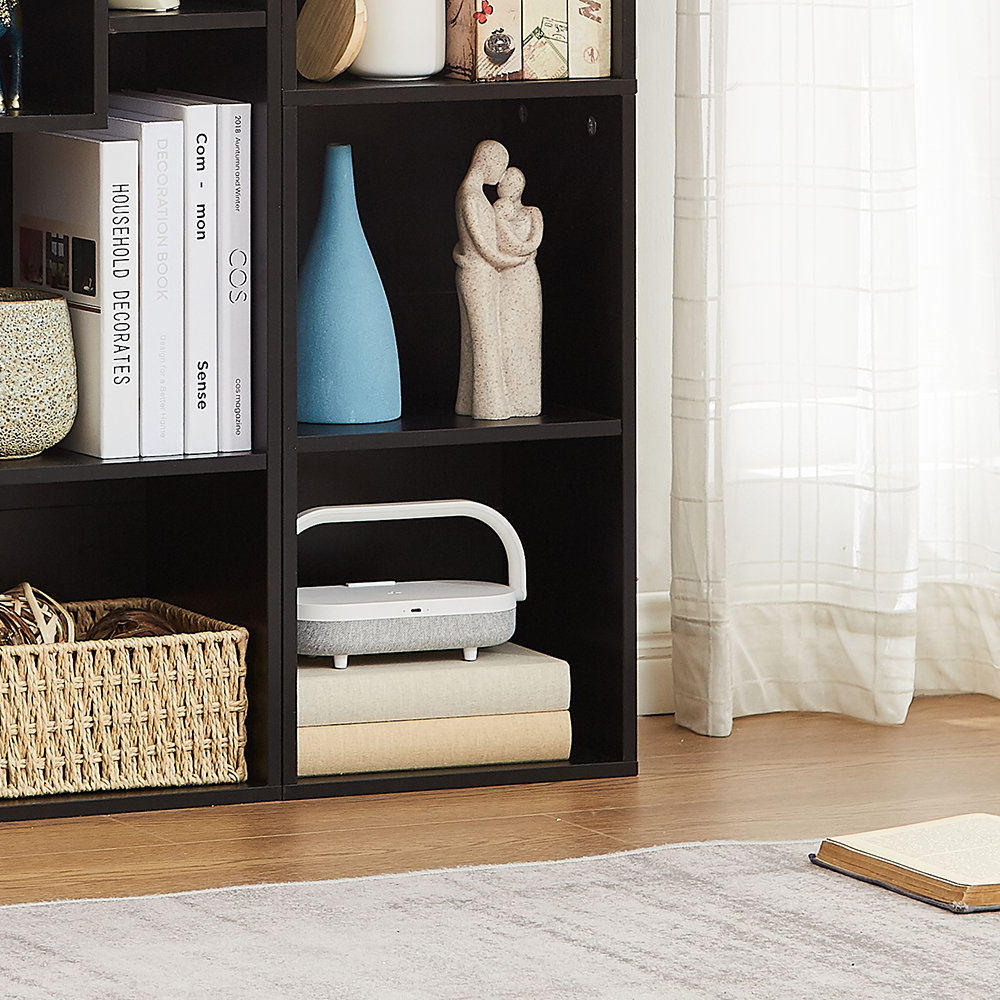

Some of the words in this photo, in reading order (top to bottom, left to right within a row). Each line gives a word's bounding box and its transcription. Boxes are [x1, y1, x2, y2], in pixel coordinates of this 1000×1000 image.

[234, 115, 242, 133] 2018
[196, 133, 208, 172] Com
[157, 138, 168, 247] DECORATION
[112, 183, 130, 279] HOUSEHOLD
[196, 203, 206, 241] mon
[157, 252, 168, 301] BOOK
[229, 248, 247, 304] COS
[113, 290, 130, 386] DECORATES
[196, 360, 209, 410] Sense
[234, 394, 242, 436] magazine
